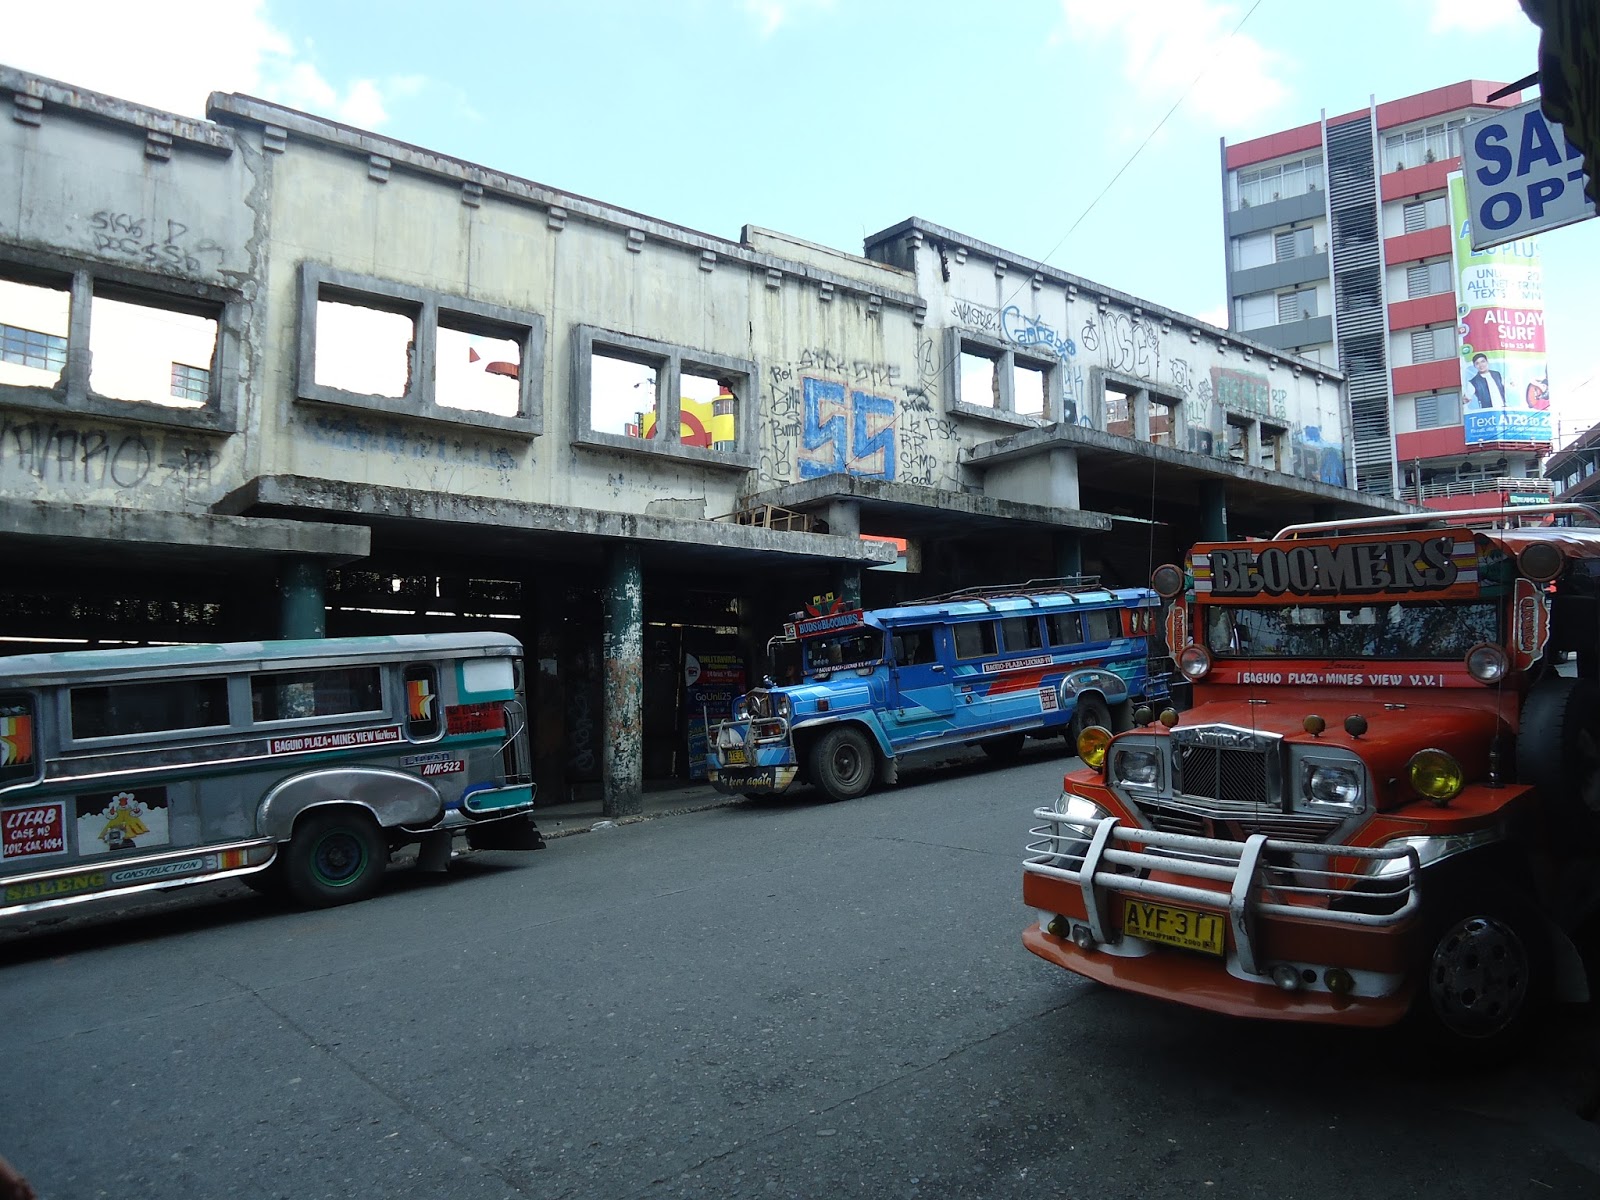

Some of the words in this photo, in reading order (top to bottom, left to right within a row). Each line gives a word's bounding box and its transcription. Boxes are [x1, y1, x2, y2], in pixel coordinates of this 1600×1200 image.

[1474, 109, 1580, 187] SA
[1480, 168, 1594, 230] OP
[1467, 279, 1489, 291] ALL
[1484, 310, 1511, 324] ALL
[1515, 311, 1544, 326] DAY
[1498, 324, 1536, 341] SURF
[1470, 415, 1497, 428] Text
[1210, 537, 1458, 596] BLOOMERS
[1243, 672, 1282, 684] BAGUIO
[1326, 672, 1364, 686] MINES
[1368, 673, 1403, 686] VIEW
[695, 692, 732, 701] GoUnli25
[274, 738, 304, 753] BAGUIO
[356, 730, 375, 743] VIEW
[11, 828, 35, 840] CASE
[115, 860, 199, 880] CONSTRUCTION
[1142, 929, 1181, 943] PHILIPPINES
